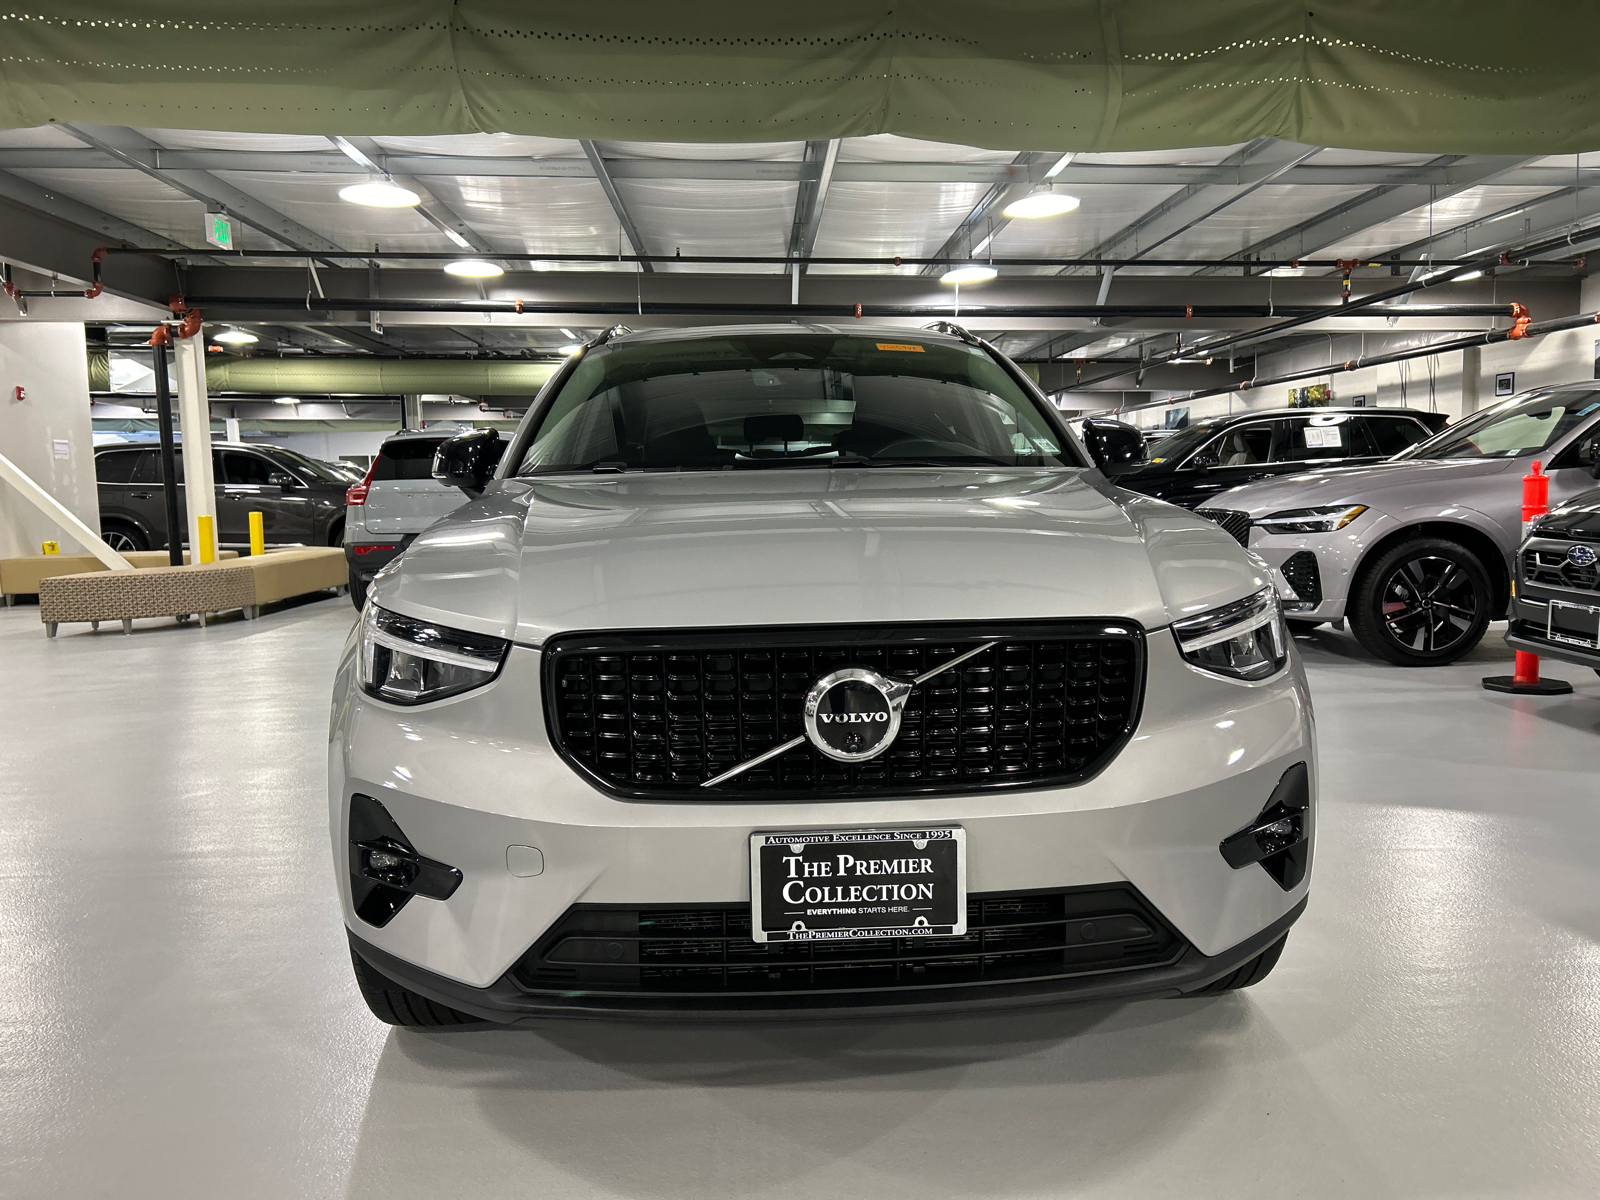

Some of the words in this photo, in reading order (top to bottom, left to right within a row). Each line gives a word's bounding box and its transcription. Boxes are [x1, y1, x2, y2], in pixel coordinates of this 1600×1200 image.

[818, 711, 889, 724] VOLVO
[767, 834, 830, 845] AUTOMOTIVE
[832, 832, 891, 843] EXCELLENCE
[893, 831, 922, 841] SINCE
[925, 830, 951, 840] 1995
[782, 855, 832, 878] THE
[836, 854, 934, 877] PREMIER
[782, 880, 934, 904] COLLECTION
[806, 907, 857, 915] EVERYTHING
[858, 906, 887, 914] STARTS
[887, 905, 910, 913] HERE.
